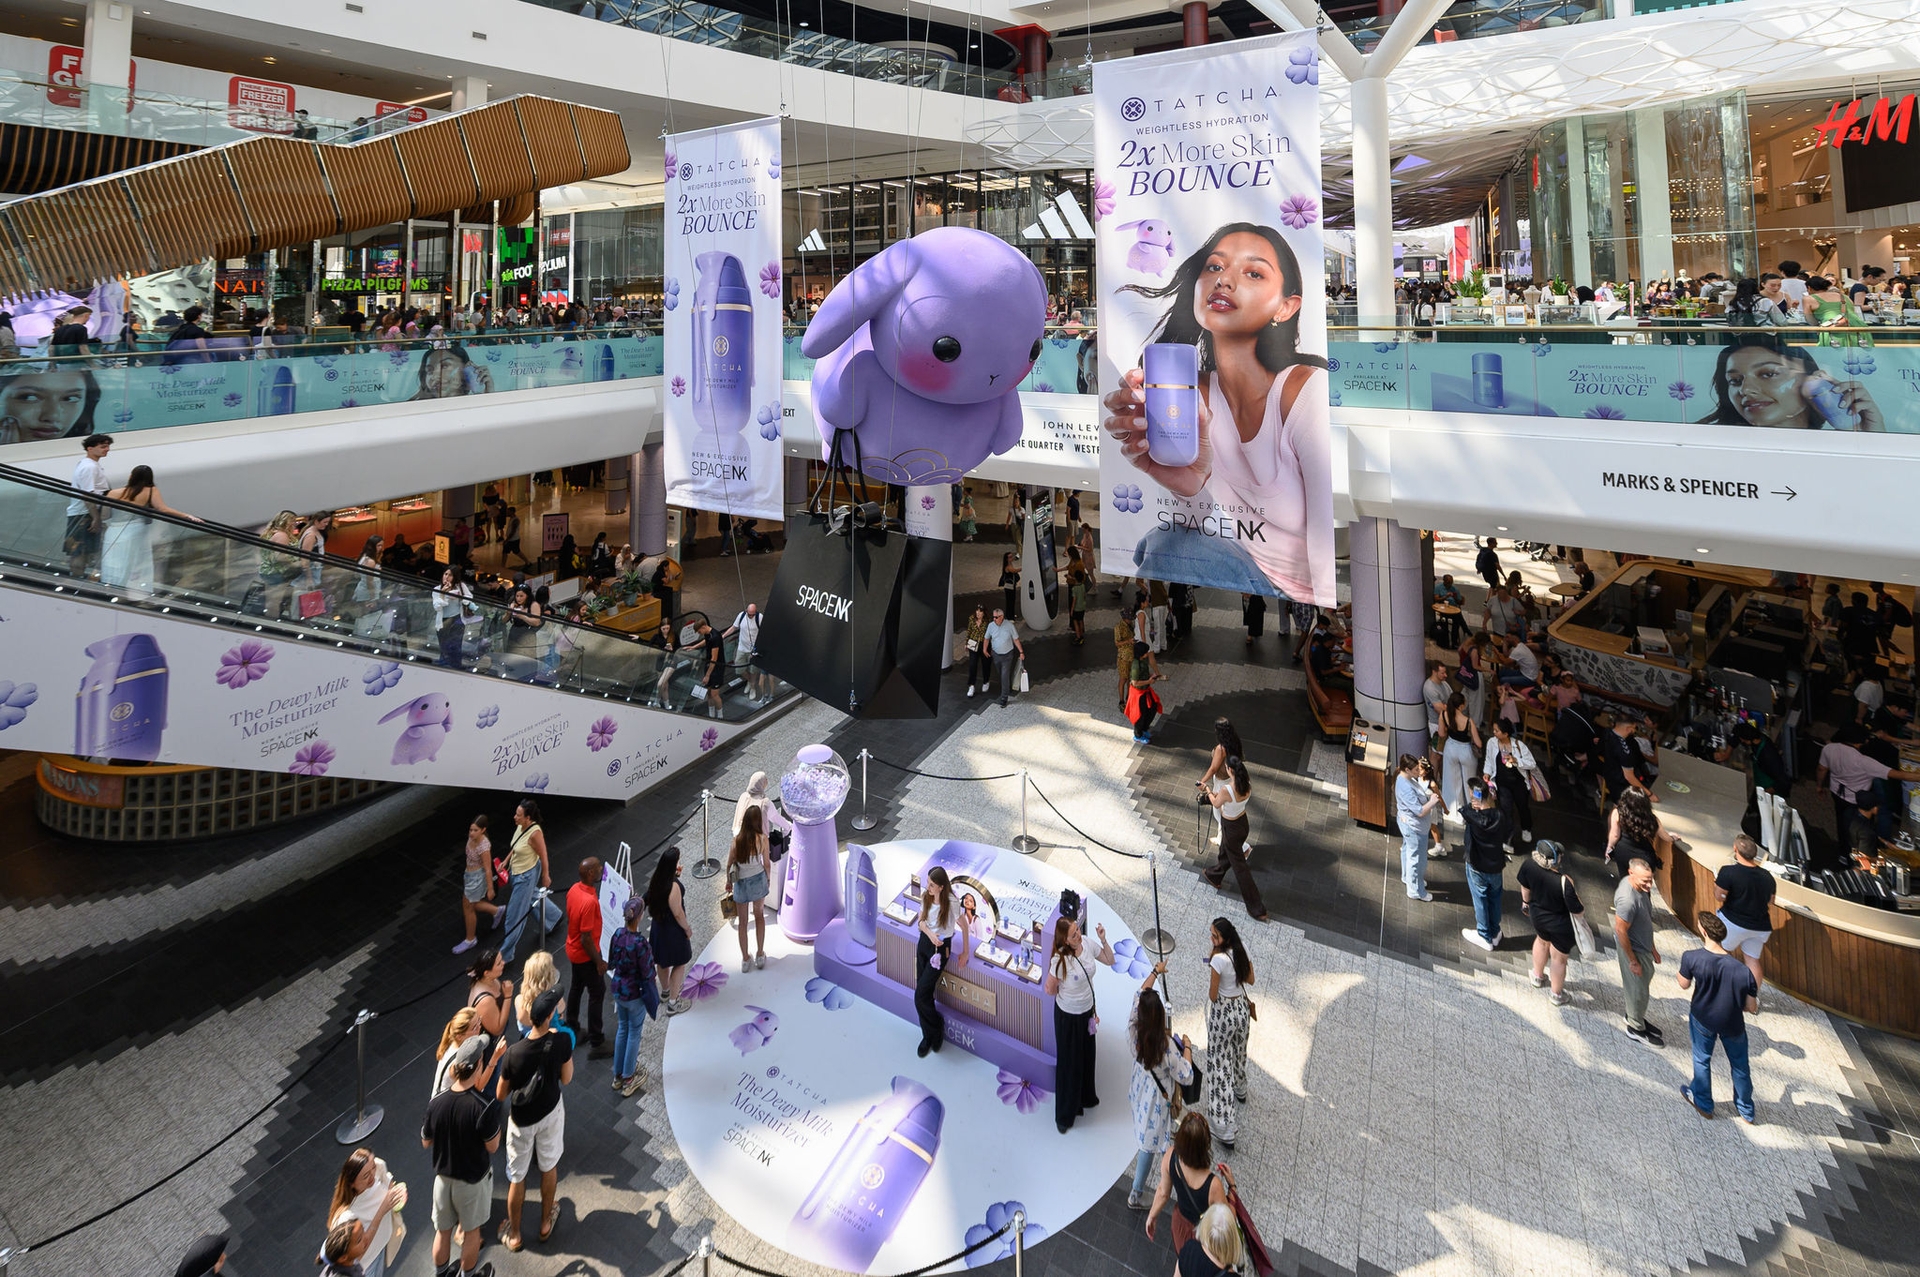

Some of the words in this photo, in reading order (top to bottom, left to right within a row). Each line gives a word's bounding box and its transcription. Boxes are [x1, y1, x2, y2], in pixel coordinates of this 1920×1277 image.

[242, 89, 284, 104] FREEZER
[1154, 86, 1278, 112] TATCHA
[1136, 121, 1202, 135] WEIGHTLESS
[1206, 113, 1269, 128] HYDRATION
[1813, 94, 1915, 149] H&M
[1117, 140, 1156, 169] 2x
[1162, 141, 1225, 164] More
[1231, 133, 1291, 158] Skin
[697, 157, 760, 174] TATCHA
[1127, 159, 1275, 197] BOUNCE
[688, 181, 721, 191] WEIGHTLESS
[723, 177, 756, 187] HYDRATION
[677, 194, 697, 214] 2x
[699, 195, 733, 212] More
[735, 191, 766, 209] Skin
[682, 210, 757, 235] BOUNCE
[321, 278, 363, 291] PIZZA
[367, 277, 429, 291] PILGRMS
[1345, 361, 1418, 370] TATCHA
[1567, 369, 1588, 382] 2x
[1591, 372, 1624, 383] More
[1626, 373, 1657, 384] Skin
[156, 387, 218, 399] Moisturizer
[341, 383, 385, 394] SPACENK
[1344, 380, 1397, 391] SPACENK
[1574, 383, 1649, 396] BOUNCE
[1042, 421, 1074, 430] JOHN
[714, 454, 748, 462] EXCLUSIVE
[1028, 440, 1064, 451] QUARTER
[691, 461, 747, 481] SPACENK
[1602, 472, 1659, 491] MARKS
[1663, 477, 1676, 492] &
[1680, 479, 1759, 499] SPENCER
[1157, 498, 1179, 507] NEW
[1200, 502, 1266, 515] EXCLUSIVE
[1157, 511, 1267, 543] SPACENK
[796, 584, 853, 623] SPACENK
[230, 709, 264, 727] The
[267, 691, 312, 716] Dewy
[314, 676, 350, 699] Milk
[241, 697, 338, 741] Moisturizer
[260, 727, 318, 758] SPACENK
[491, 745, 512, 764] 2x
[514, 732, 544, 752] More
[545, 720, 569, 739] Skin
[496, 732, 562, 776] BOUNCE
[625, 729, 682, 764] TATCHA
[625, 755, 668, 788] SPACENK
[941, 977, 991, 1008] ATCHA
[781, 1074, 828, 1105] TATCHA
[737, 1072, 764, 1097] The
[760, 1088, 801, 1119] Dewy
[797, 1110, 833, 1136] Milk
[730, 1092, 810, 1148] Moisturizer
[723, 1128, 775, 1167] SPACENK
